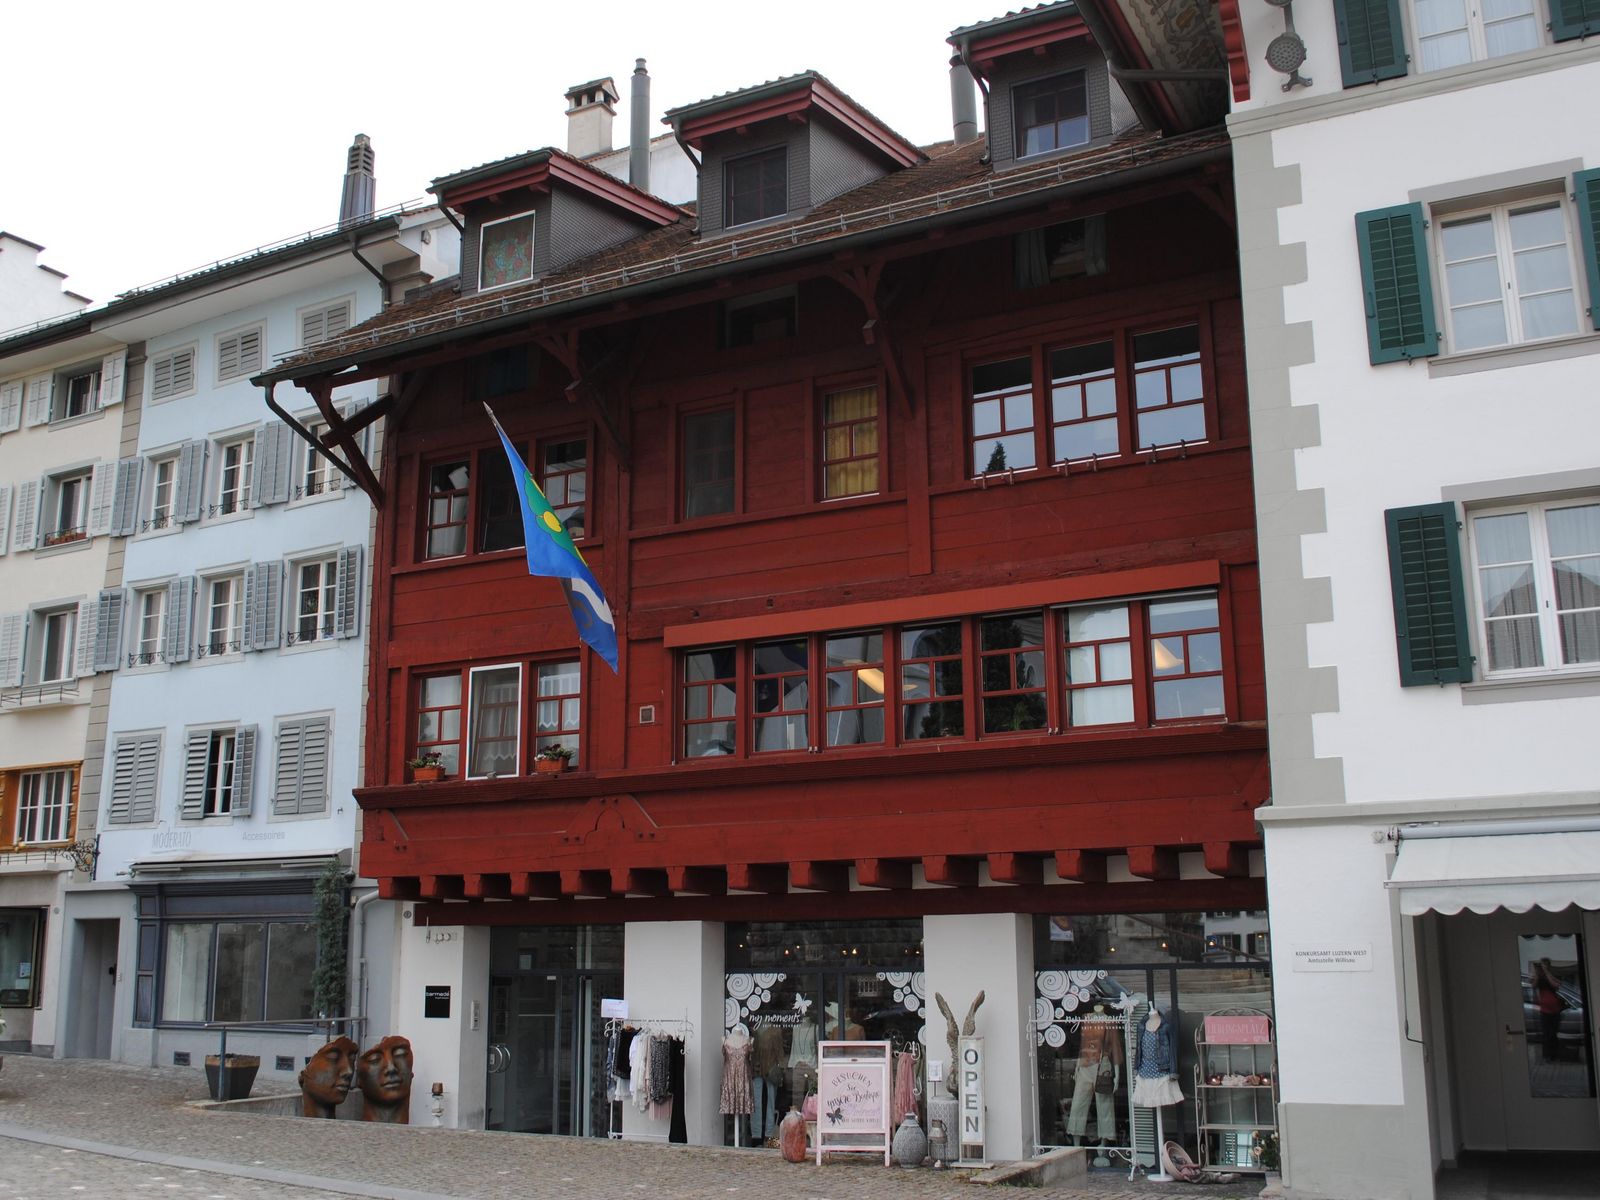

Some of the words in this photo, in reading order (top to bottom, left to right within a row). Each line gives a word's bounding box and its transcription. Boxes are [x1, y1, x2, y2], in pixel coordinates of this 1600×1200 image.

[749, 1014, 763, 1031] my
[764, 1012, 800, 1023] moments
[964, 1048, 979, 1133] OPEN
